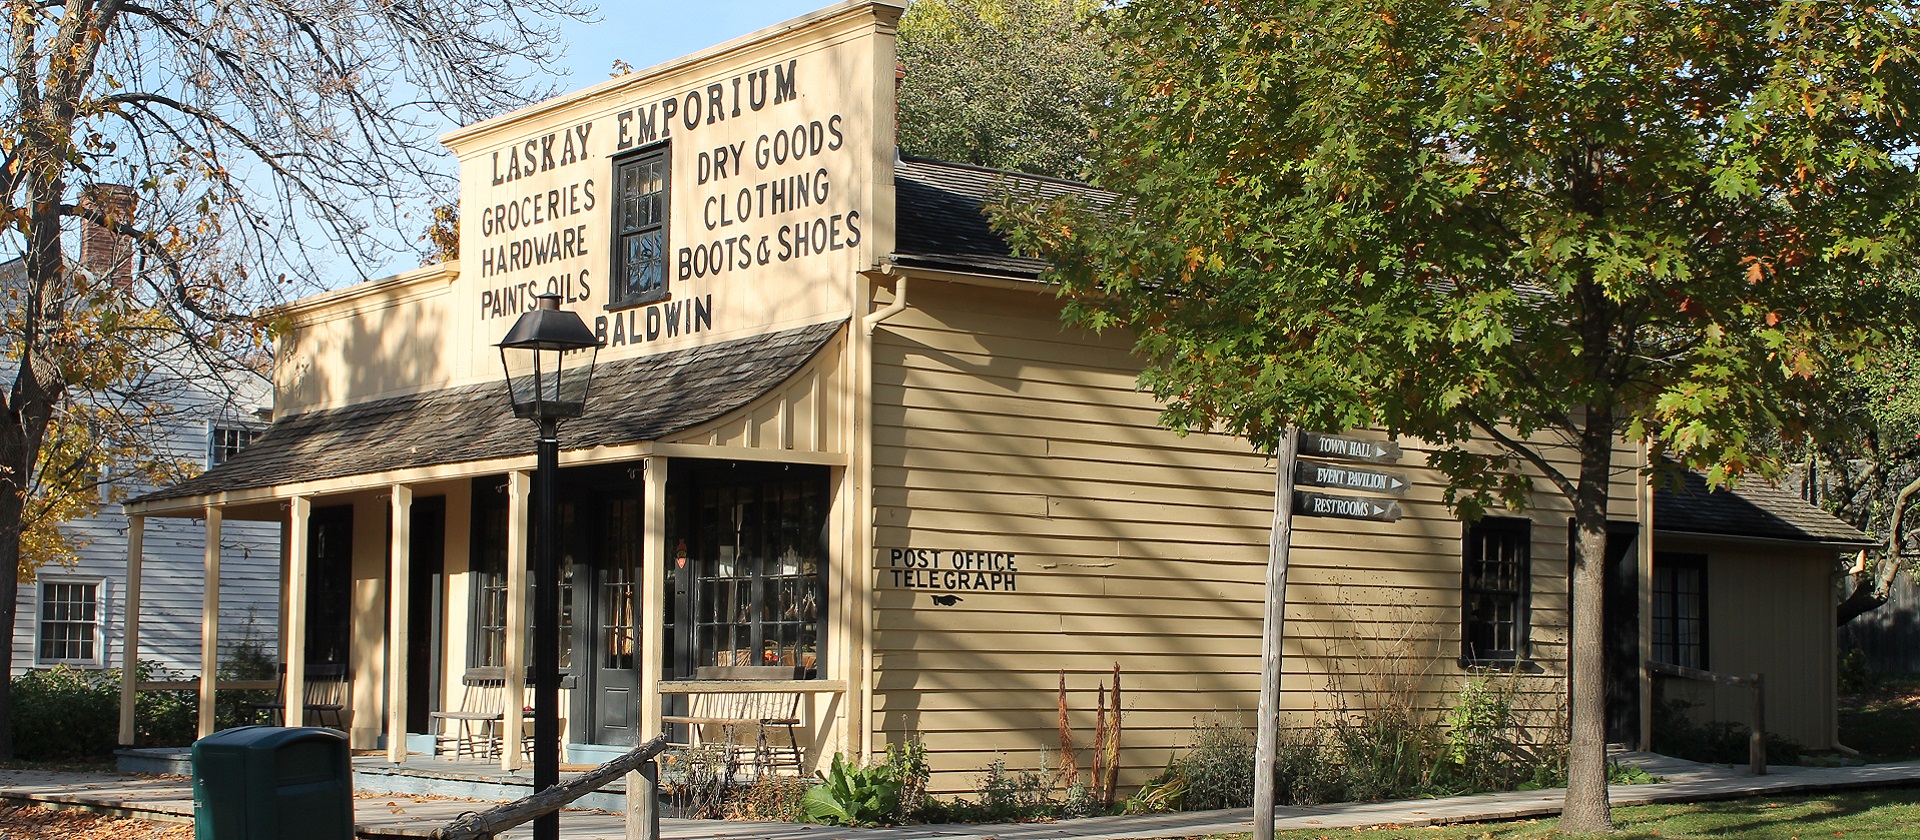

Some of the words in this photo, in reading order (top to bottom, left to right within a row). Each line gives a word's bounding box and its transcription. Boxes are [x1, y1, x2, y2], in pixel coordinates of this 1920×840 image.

[492, 122, 593, 186] LASKAY
[617, 59, 796, 150] EMPORIUM
[697, 140, 746, 185] DRY
[755, 114, 843, 170] GOODS
[482, 179, 596, 237] GROCERIES
[704, 168, 829, 231] CLOTHING
[482, 224, 588, 278] HARDWARE
[678, 234, 752, 281] BOOTS
[756, 235, 771, 266] &
[777, 210, 861, 261] SHOES
[481, 280, 538, 320] PAINTS
[596, 294, 712, 349] BALDWIN
[1319, 437, 1347, 454] TOWN
[1348, 441, 1371, 457] HALL
[1317, 467, 1346, 484] EVENT
[1346, 471, 1387, 489] PAVILION
[1313, 497, 1368, 516] RESTROOMS
[890, 548, 941, 568] POST
[952, 550, 1017, 572] OFFICE
[890, 569, 1016, 591] TELEGRAPH
